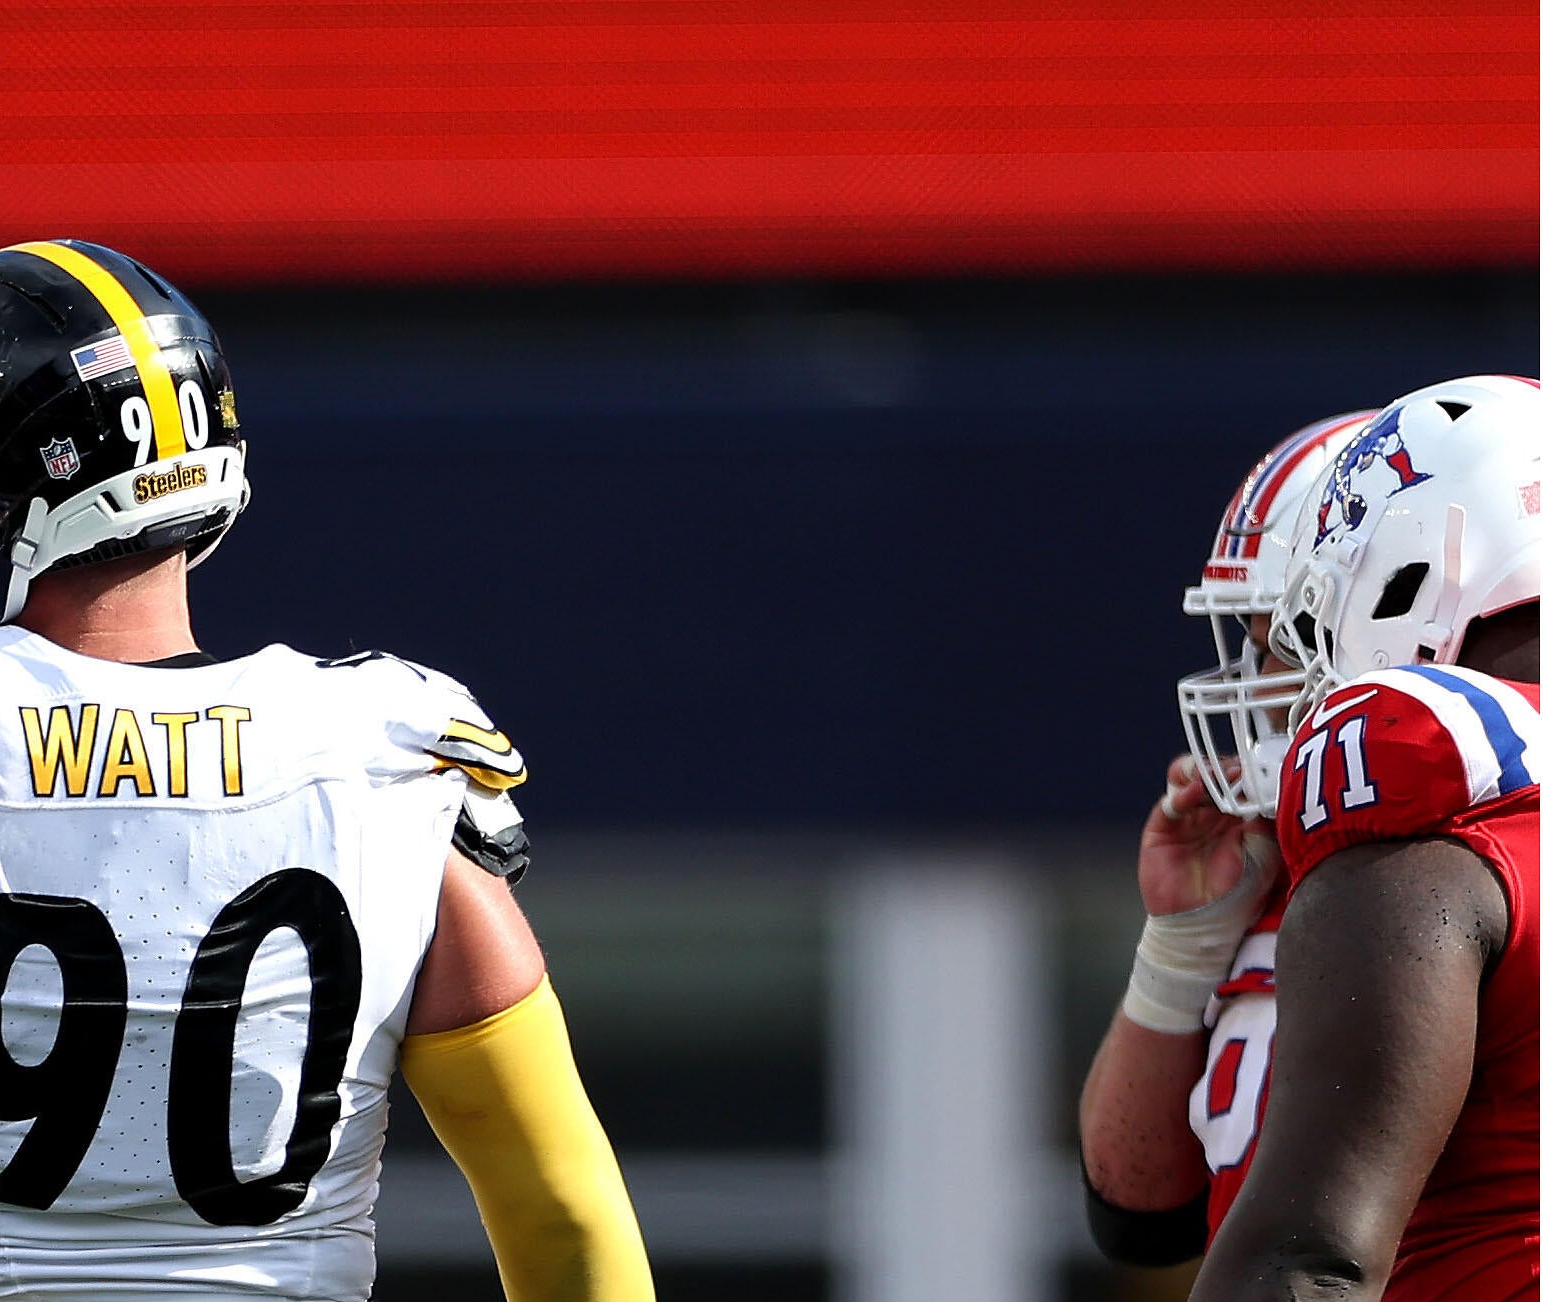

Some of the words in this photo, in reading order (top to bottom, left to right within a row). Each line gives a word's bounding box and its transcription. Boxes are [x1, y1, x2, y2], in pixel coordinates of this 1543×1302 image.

[49, 452, 76, 475] NFL
[120, 380, 209, 467] 90
[132, 462, 208, 505] Steelers
[19, 703, 252, 799] WATT
[1293, 715, 1378, 832] 71
